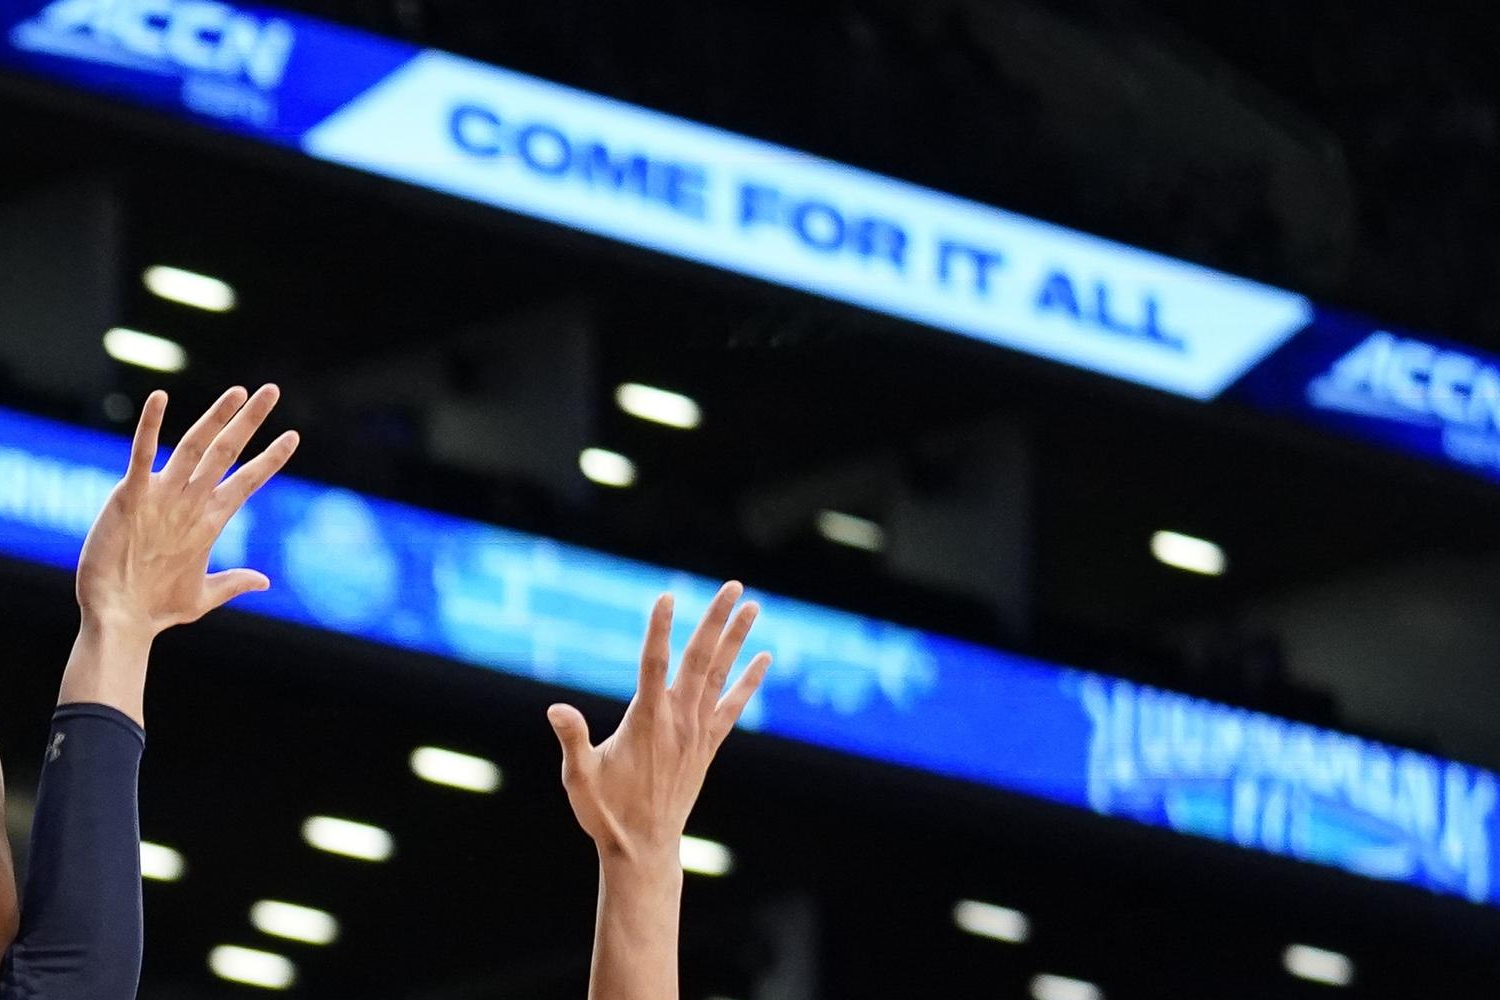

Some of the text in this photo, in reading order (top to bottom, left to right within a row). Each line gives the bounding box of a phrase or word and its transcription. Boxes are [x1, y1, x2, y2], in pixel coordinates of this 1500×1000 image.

[450, 104, 1188, 354] COME FOR IT ALL
